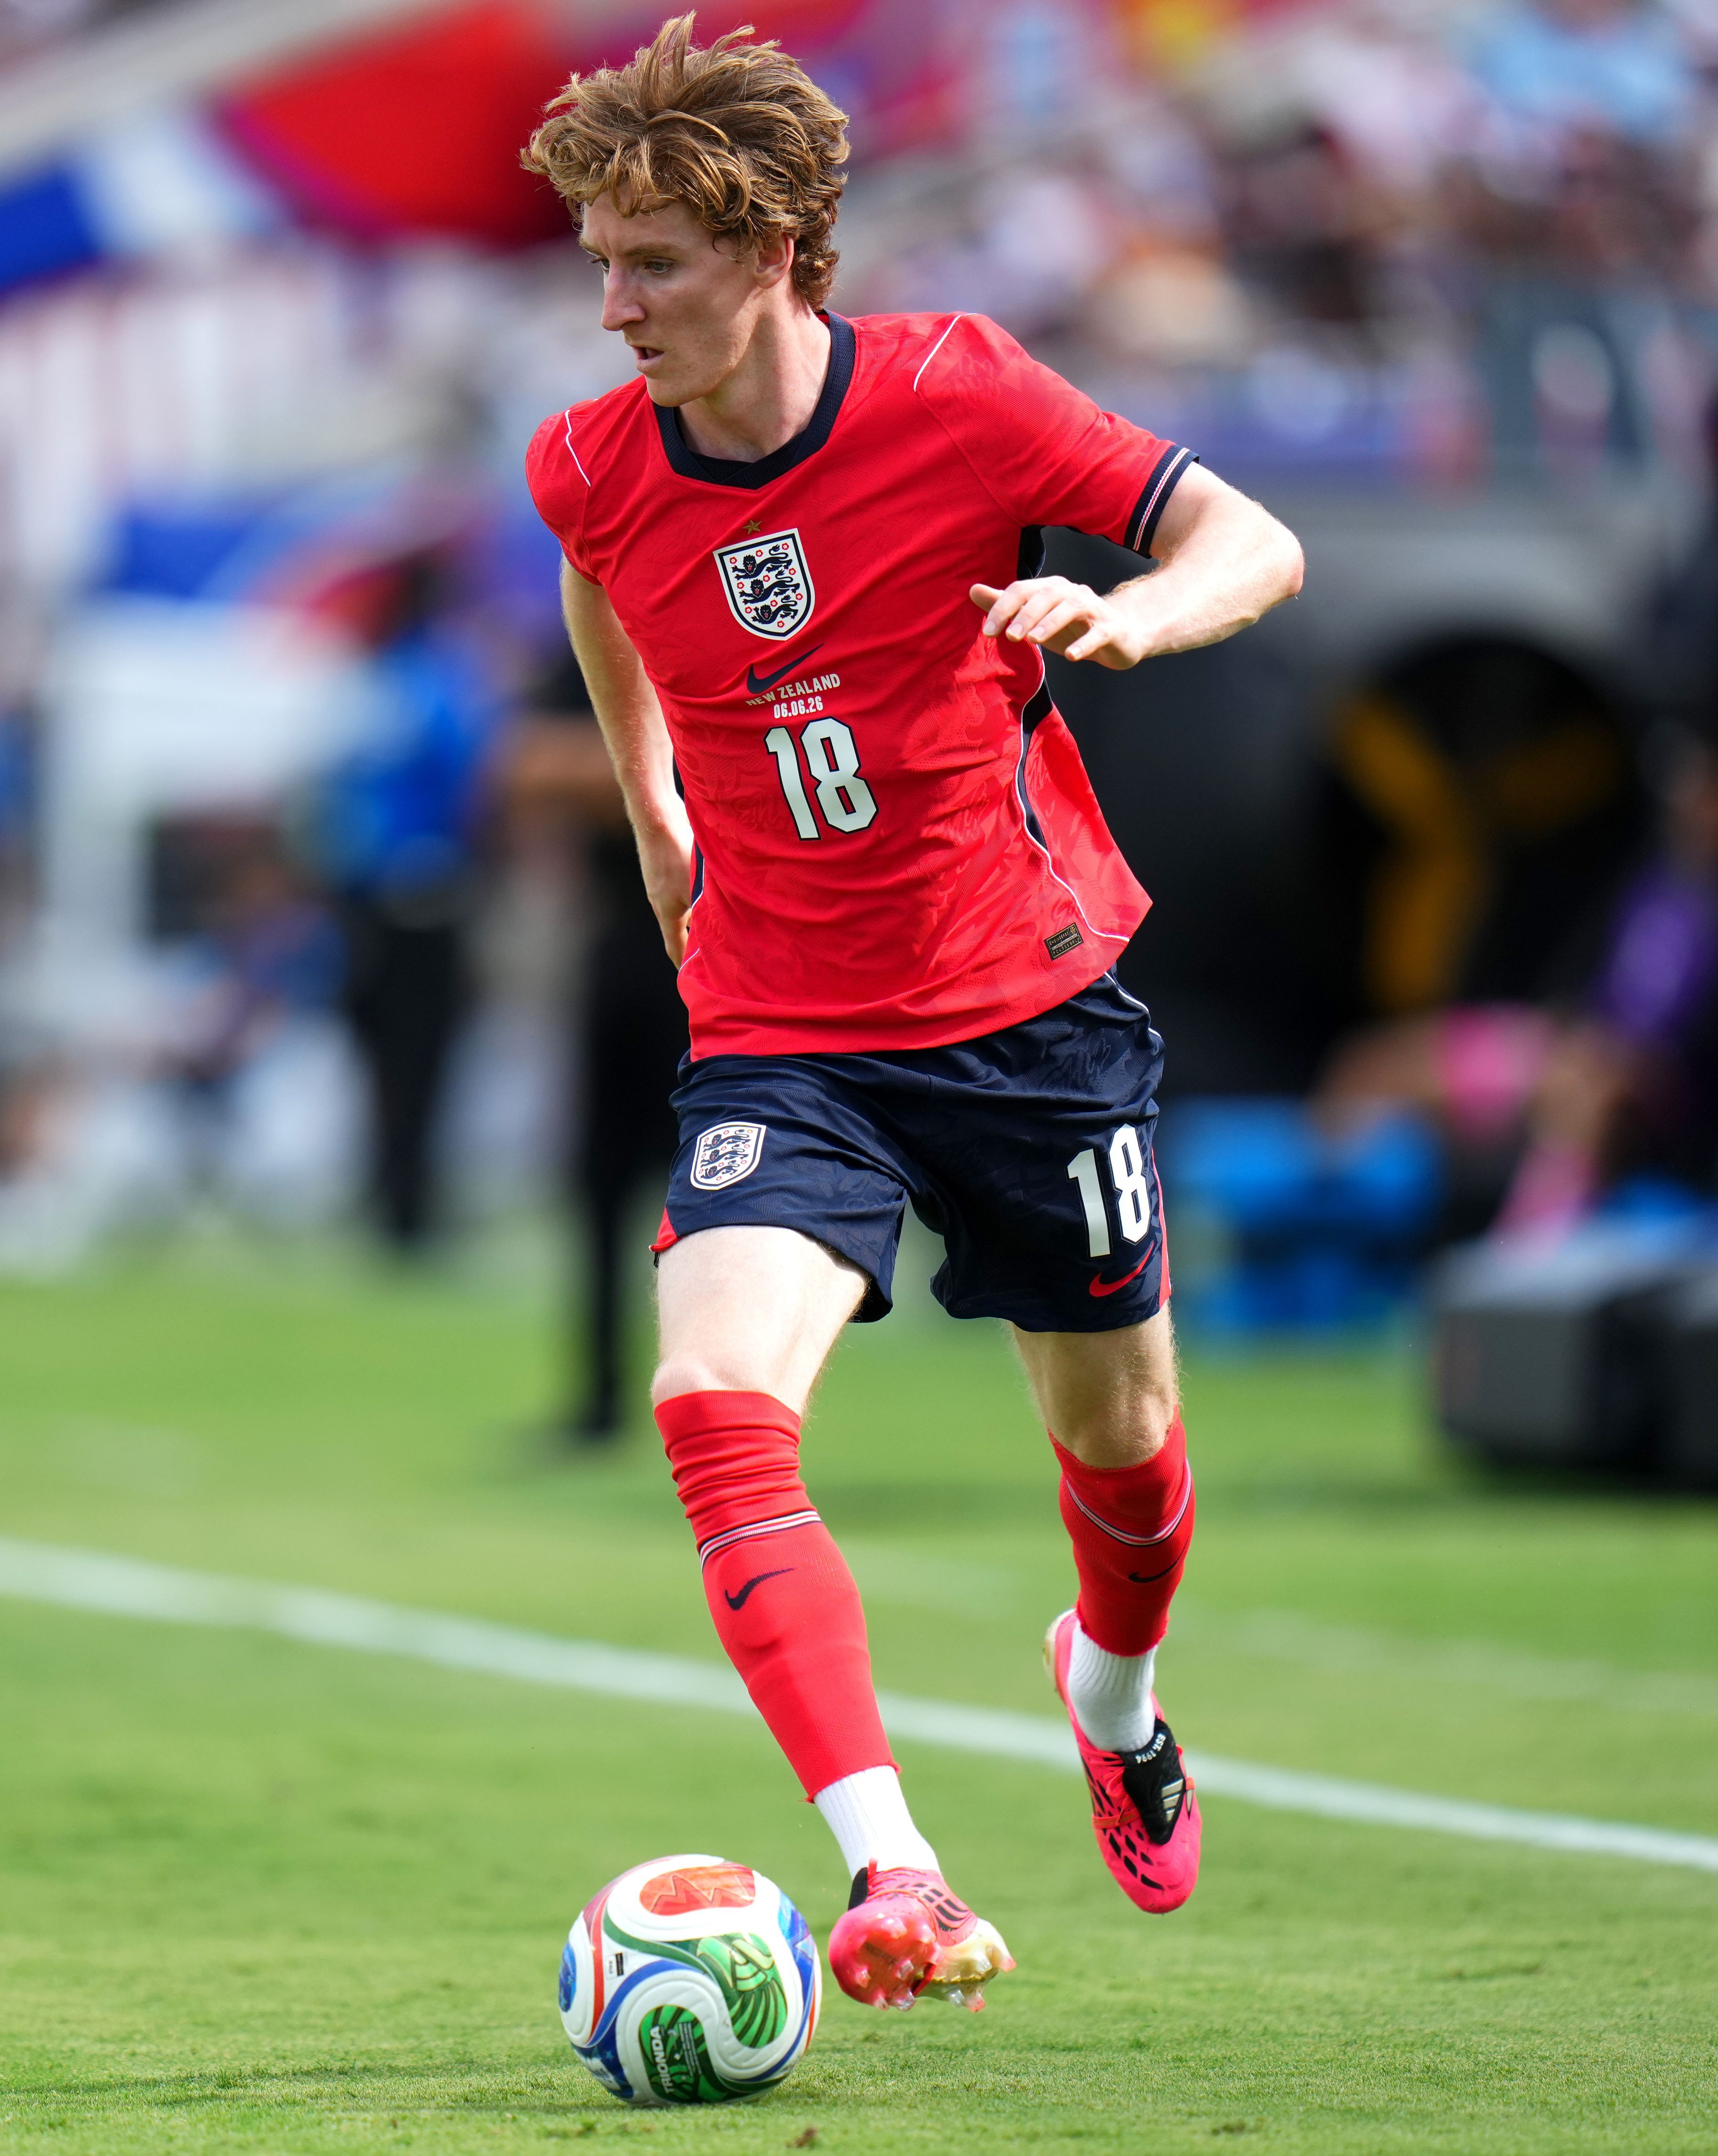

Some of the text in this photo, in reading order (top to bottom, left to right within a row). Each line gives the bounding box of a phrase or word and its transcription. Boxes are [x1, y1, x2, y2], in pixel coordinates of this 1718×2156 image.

[745, 674, 840, 706] NEW ZEALAND
[773, 696, 823, 718] 06.06.26
[763, 716, 879, 840] 18
[1066, 1122, 1151, 1258] 18
[650, 2026, 674, 2093] TRIONDA
